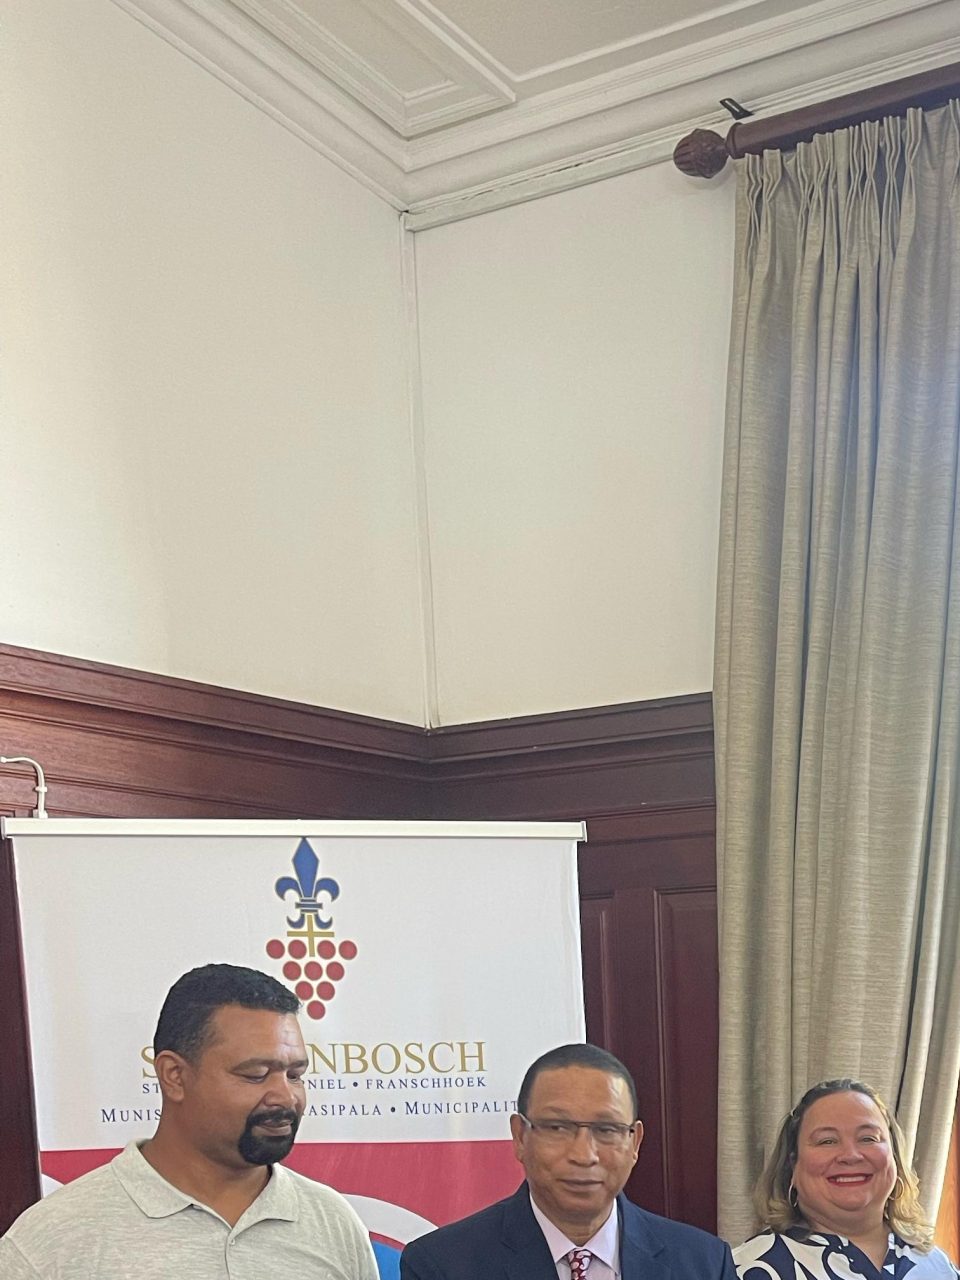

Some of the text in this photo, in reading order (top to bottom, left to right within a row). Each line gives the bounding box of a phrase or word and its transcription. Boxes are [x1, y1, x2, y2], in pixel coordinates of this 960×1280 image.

[141, 1041, 487, 1078] SNBOSCH
[302, 1076, 486, 1090] NIEL FRANSCHHOEK
[303, 1100, 518, 1116] ASIPALA MUNICIPALIT
